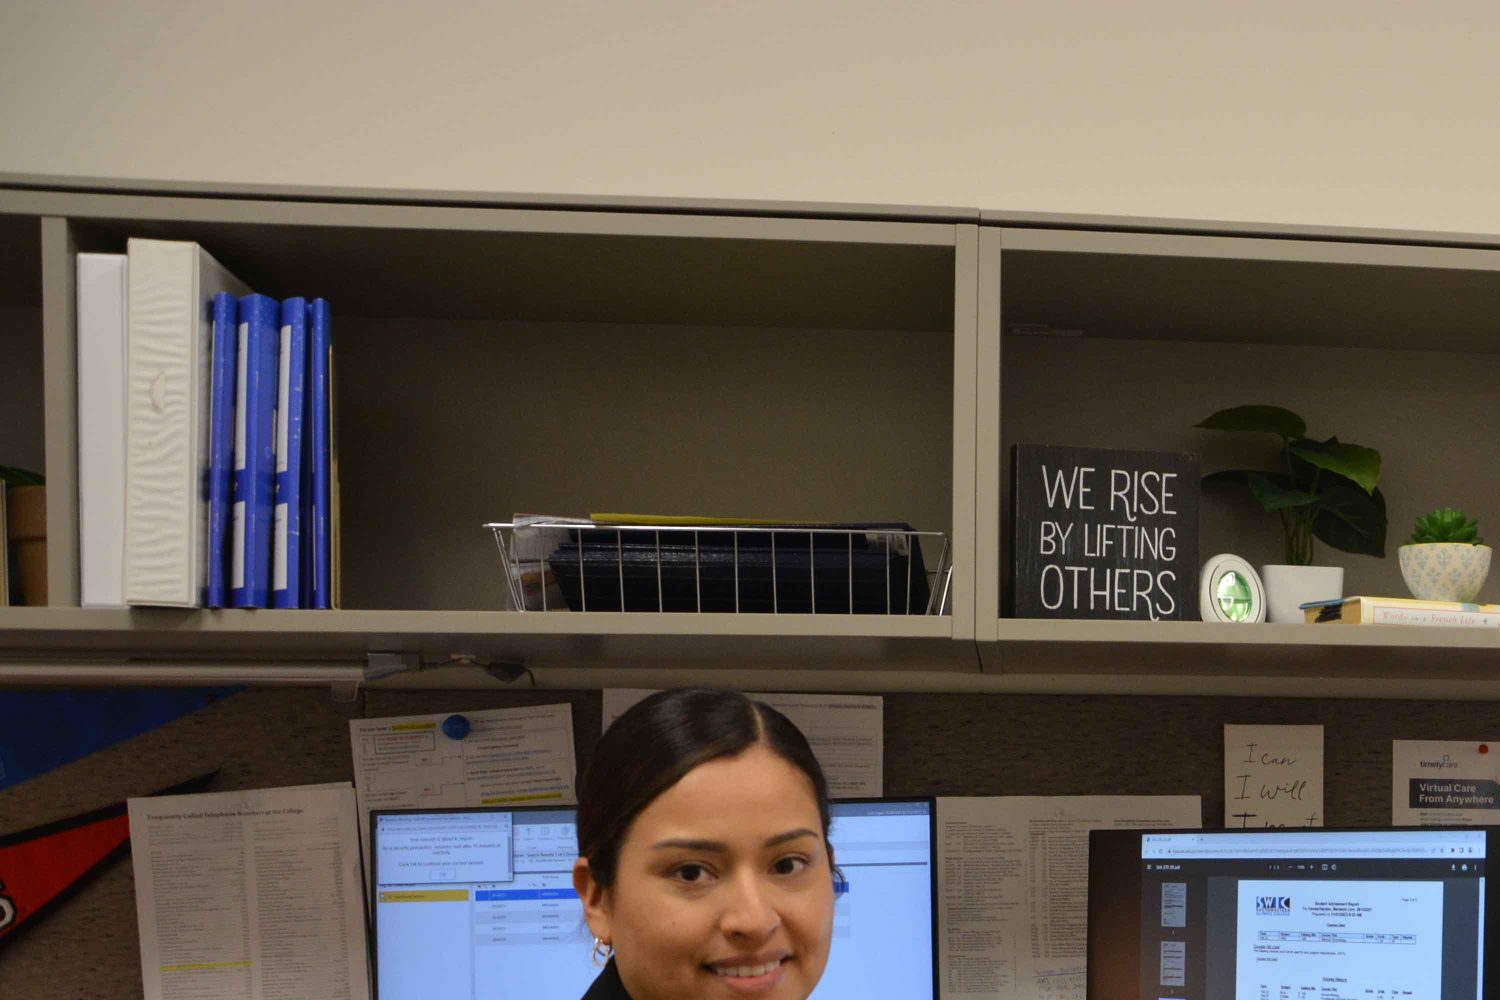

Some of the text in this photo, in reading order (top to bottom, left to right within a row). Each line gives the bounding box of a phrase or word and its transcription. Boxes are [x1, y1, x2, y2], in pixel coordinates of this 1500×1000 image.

[1041, 464, 1178, 523] WE RISE
[1039, 520, 1177, 562] BY LIFTING
[1040, 563, 1177, 622] OTHERS
[1430, 614, 1458, 624] French
[1243, 743, 1297, 766] I can
[1234, 774, 1308, 801] I will
[1420, 783, 1477, 793] Virtual Care
[1420, 794, 1495, 805] From Anywhere
[1256, 896, 1291, 909] SWIC
